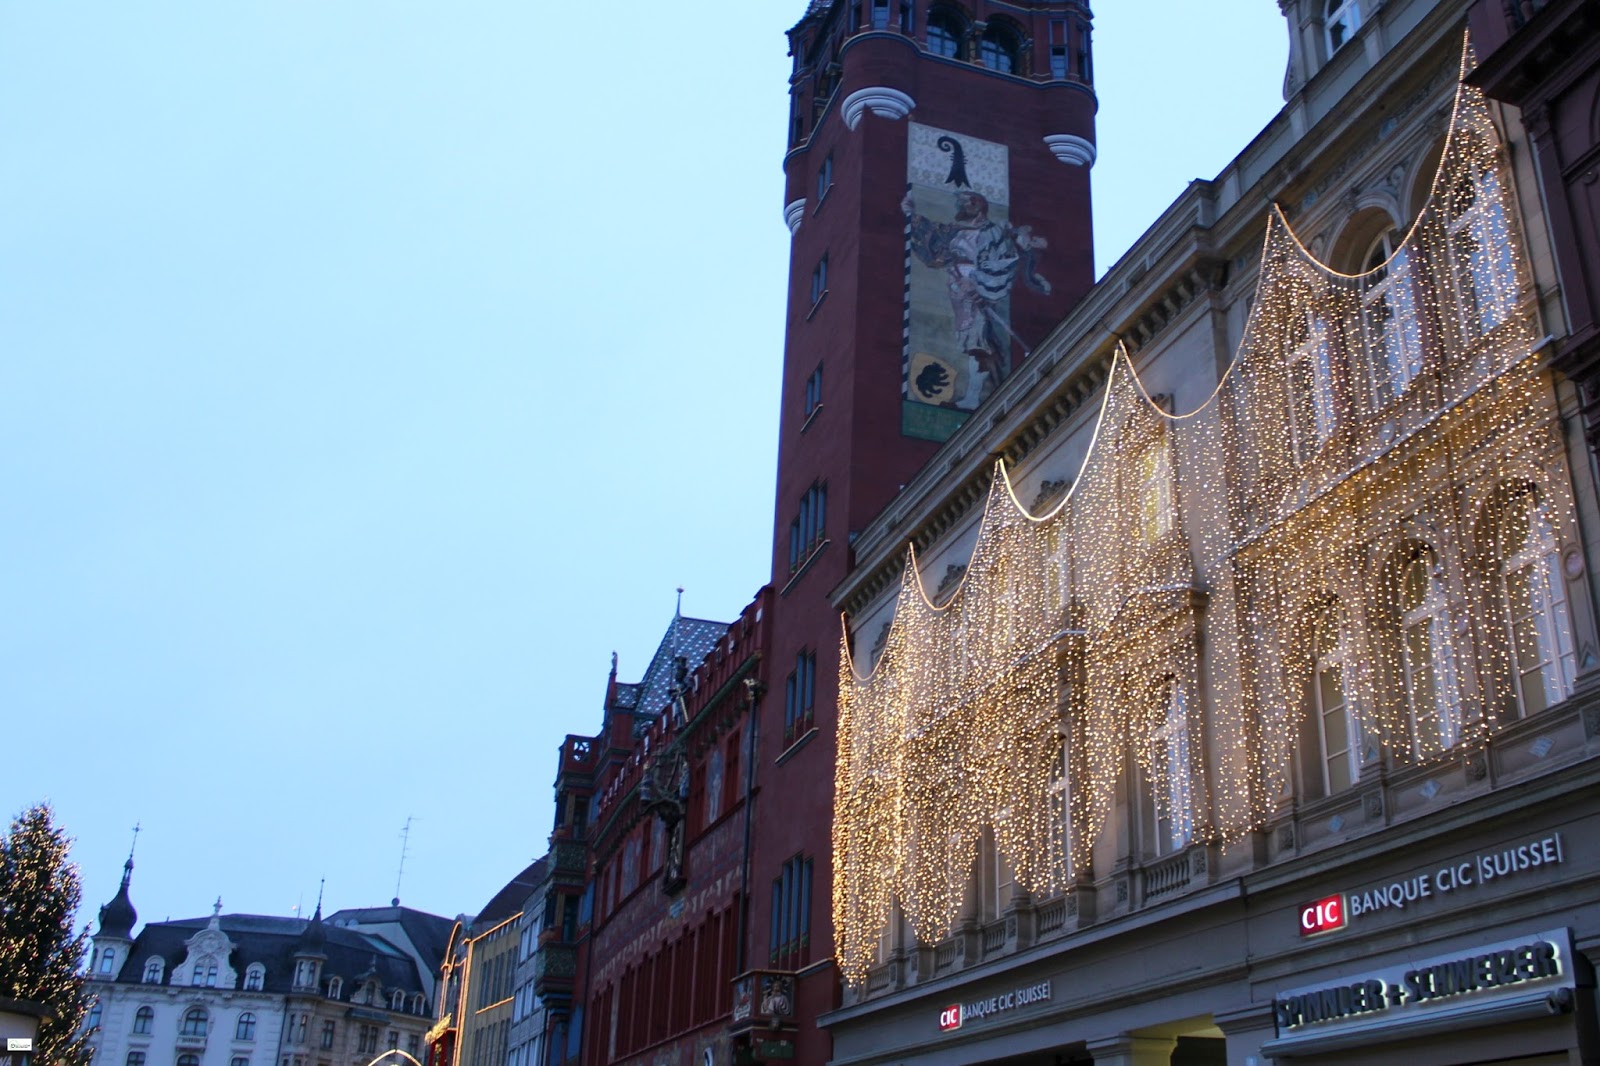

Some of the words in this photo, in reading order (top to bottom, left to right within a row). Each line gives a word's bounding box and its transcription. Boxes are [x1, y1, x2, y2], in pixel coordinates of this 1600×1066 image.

[1301, 900, 1338, 929] CIC
[1350, 875, 1430, 917] BANQUE
[1436, 863, 1472, 892] CIC
[1404, 941, 1563, 1003] SCHWEIZER
[940, 1008, 957, 1027] CIC
[962, 998, 997, 1019] BANQUE
[998, 993, 1014, 1010] CIC
